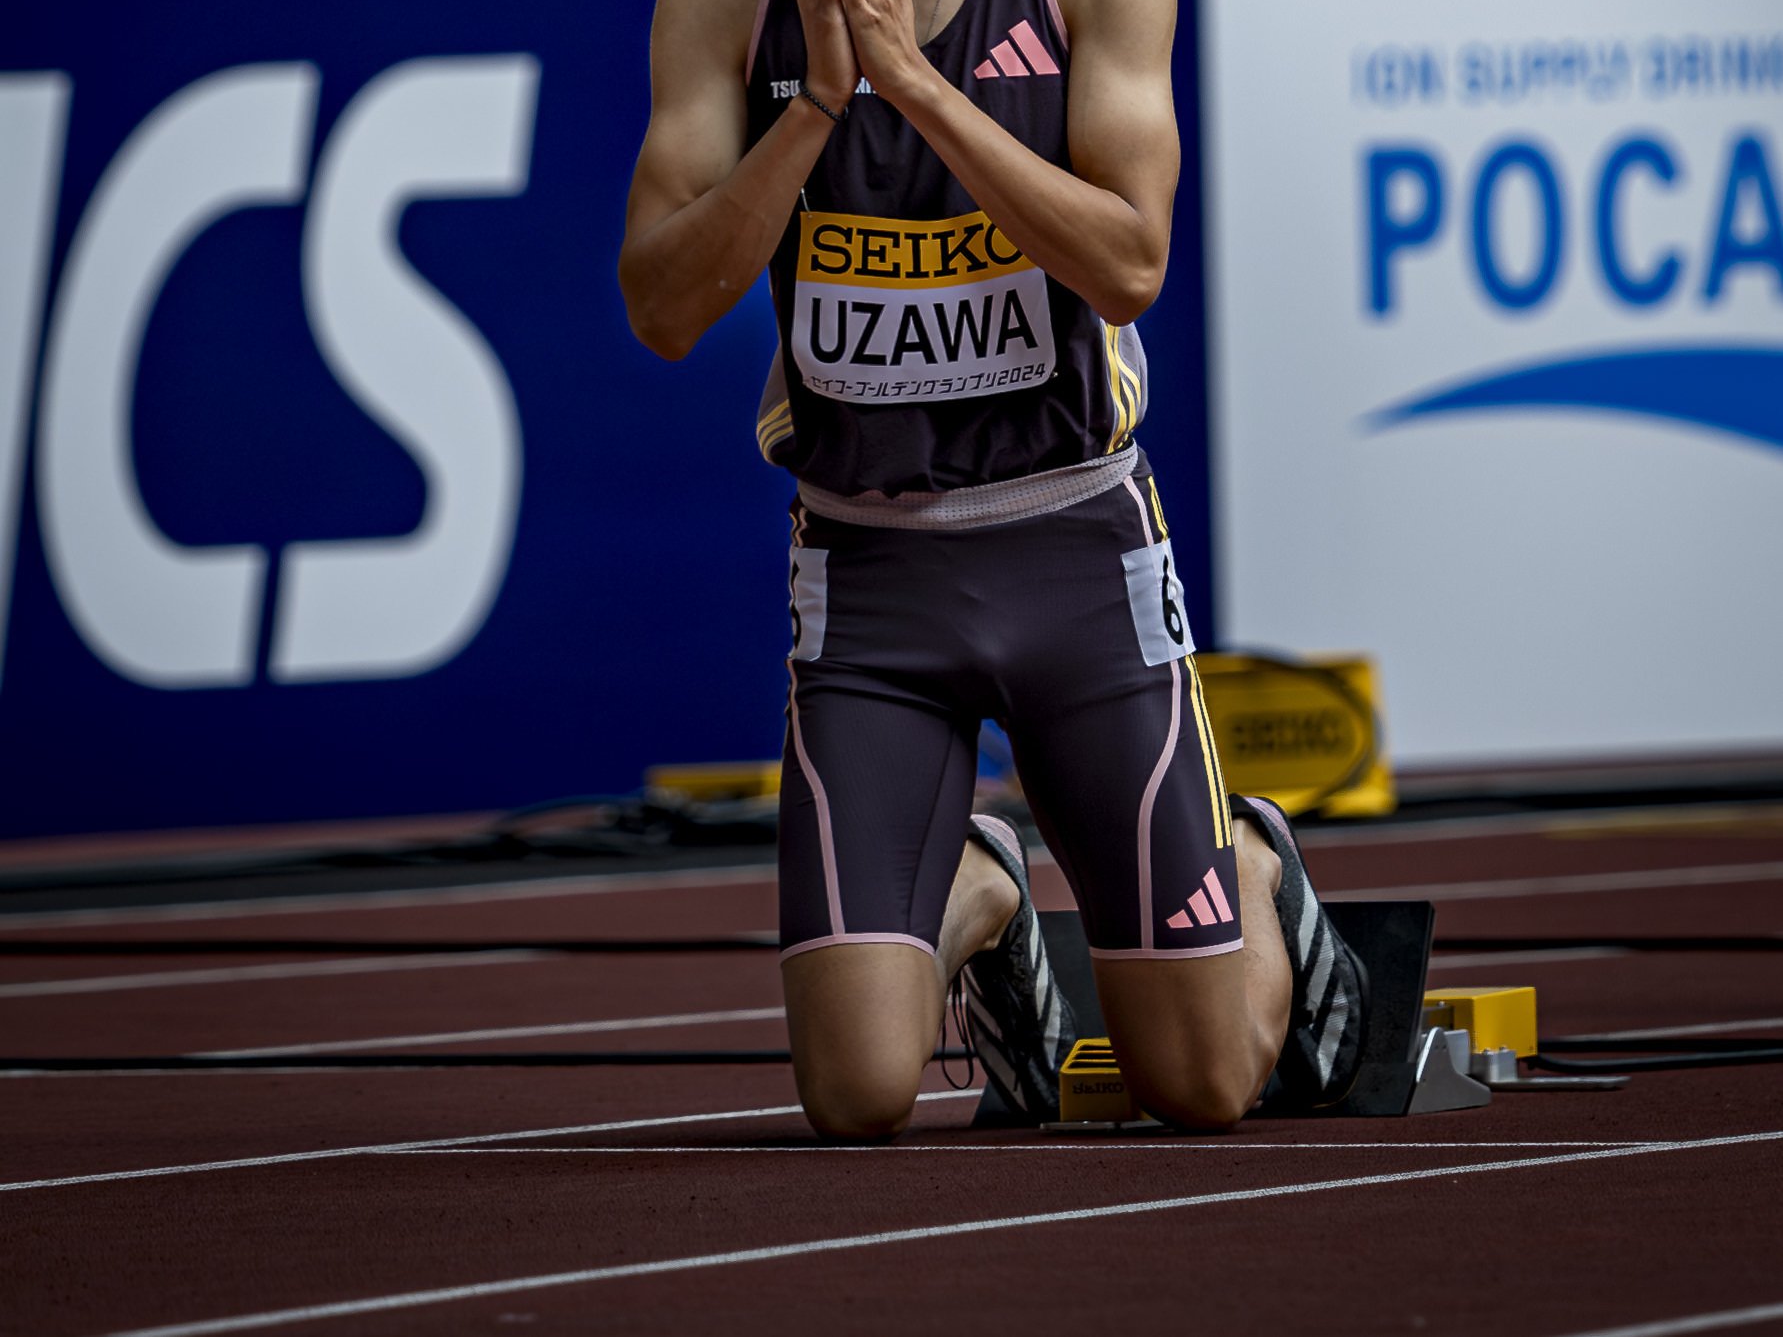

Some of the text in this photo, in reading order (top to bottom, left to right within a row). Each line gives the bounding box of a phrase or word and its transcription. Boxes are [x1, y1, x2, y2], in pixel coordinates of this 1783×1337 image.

[810, 222, 1024, 279] SEIKO
[1364, 129, 1783, 317] POCA
[810, 288, 1039, 366] UZAWA
[1161, 553, 1184, 646] 6
